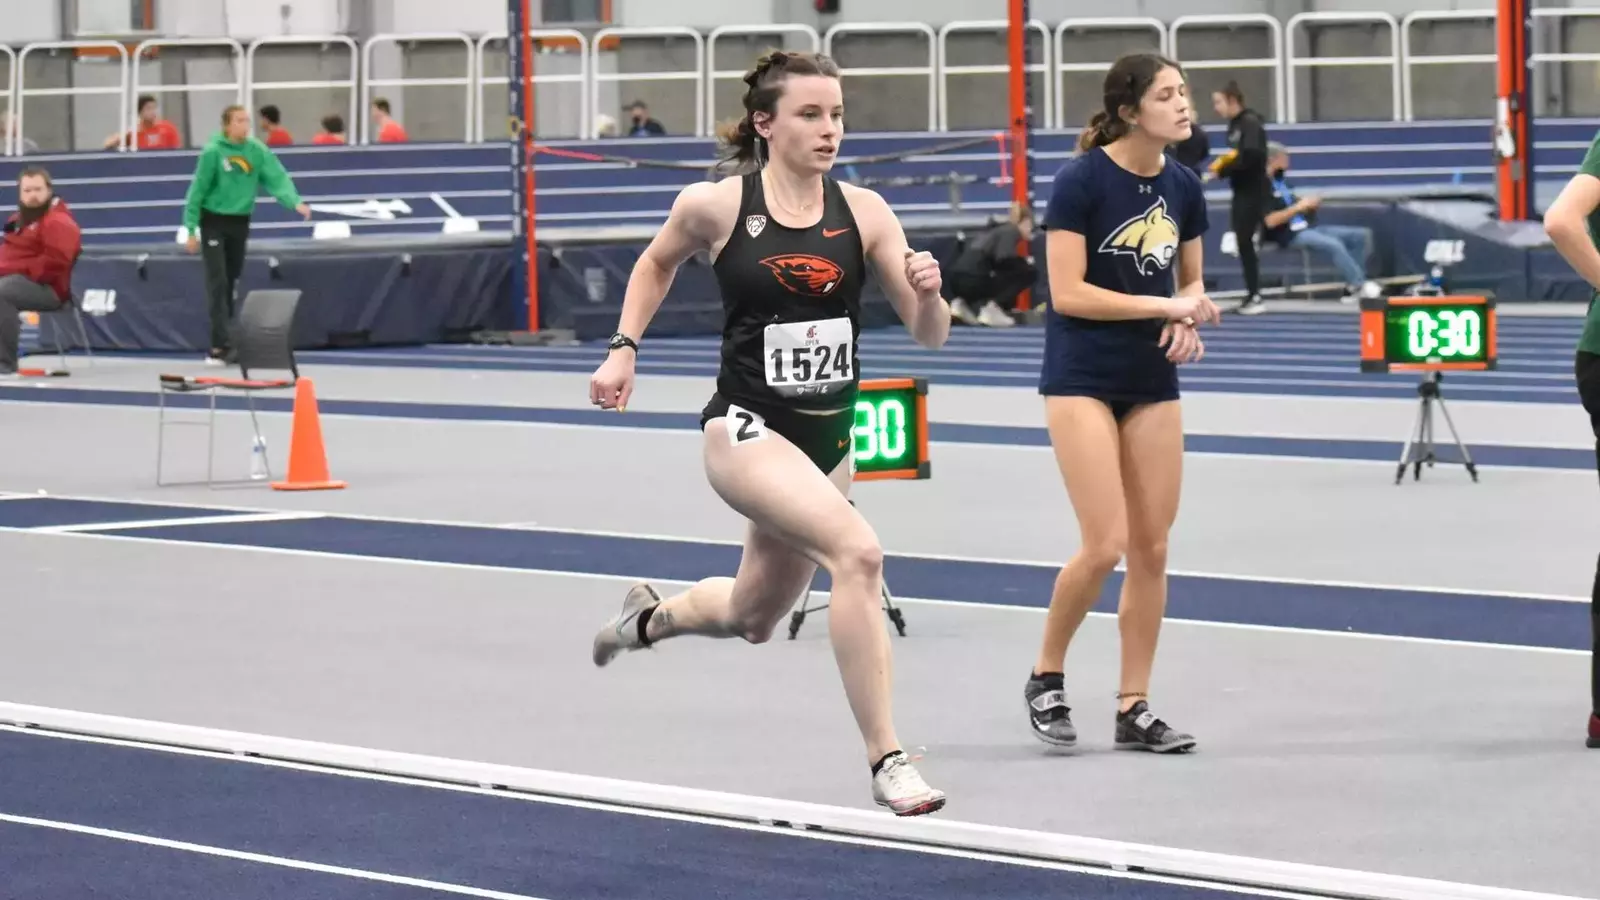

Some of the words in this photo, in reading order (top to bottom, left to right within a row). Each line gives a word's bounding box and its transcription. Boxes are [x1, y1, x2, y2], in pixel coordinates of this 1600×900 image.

[750, 225, 761, 233] 12
[1408, 310, 1480, 356] 0:30
[771, 343, 850, 382] 1524
[735, 411, 759, 442] 2
[854, 399, 906, 461] 30
